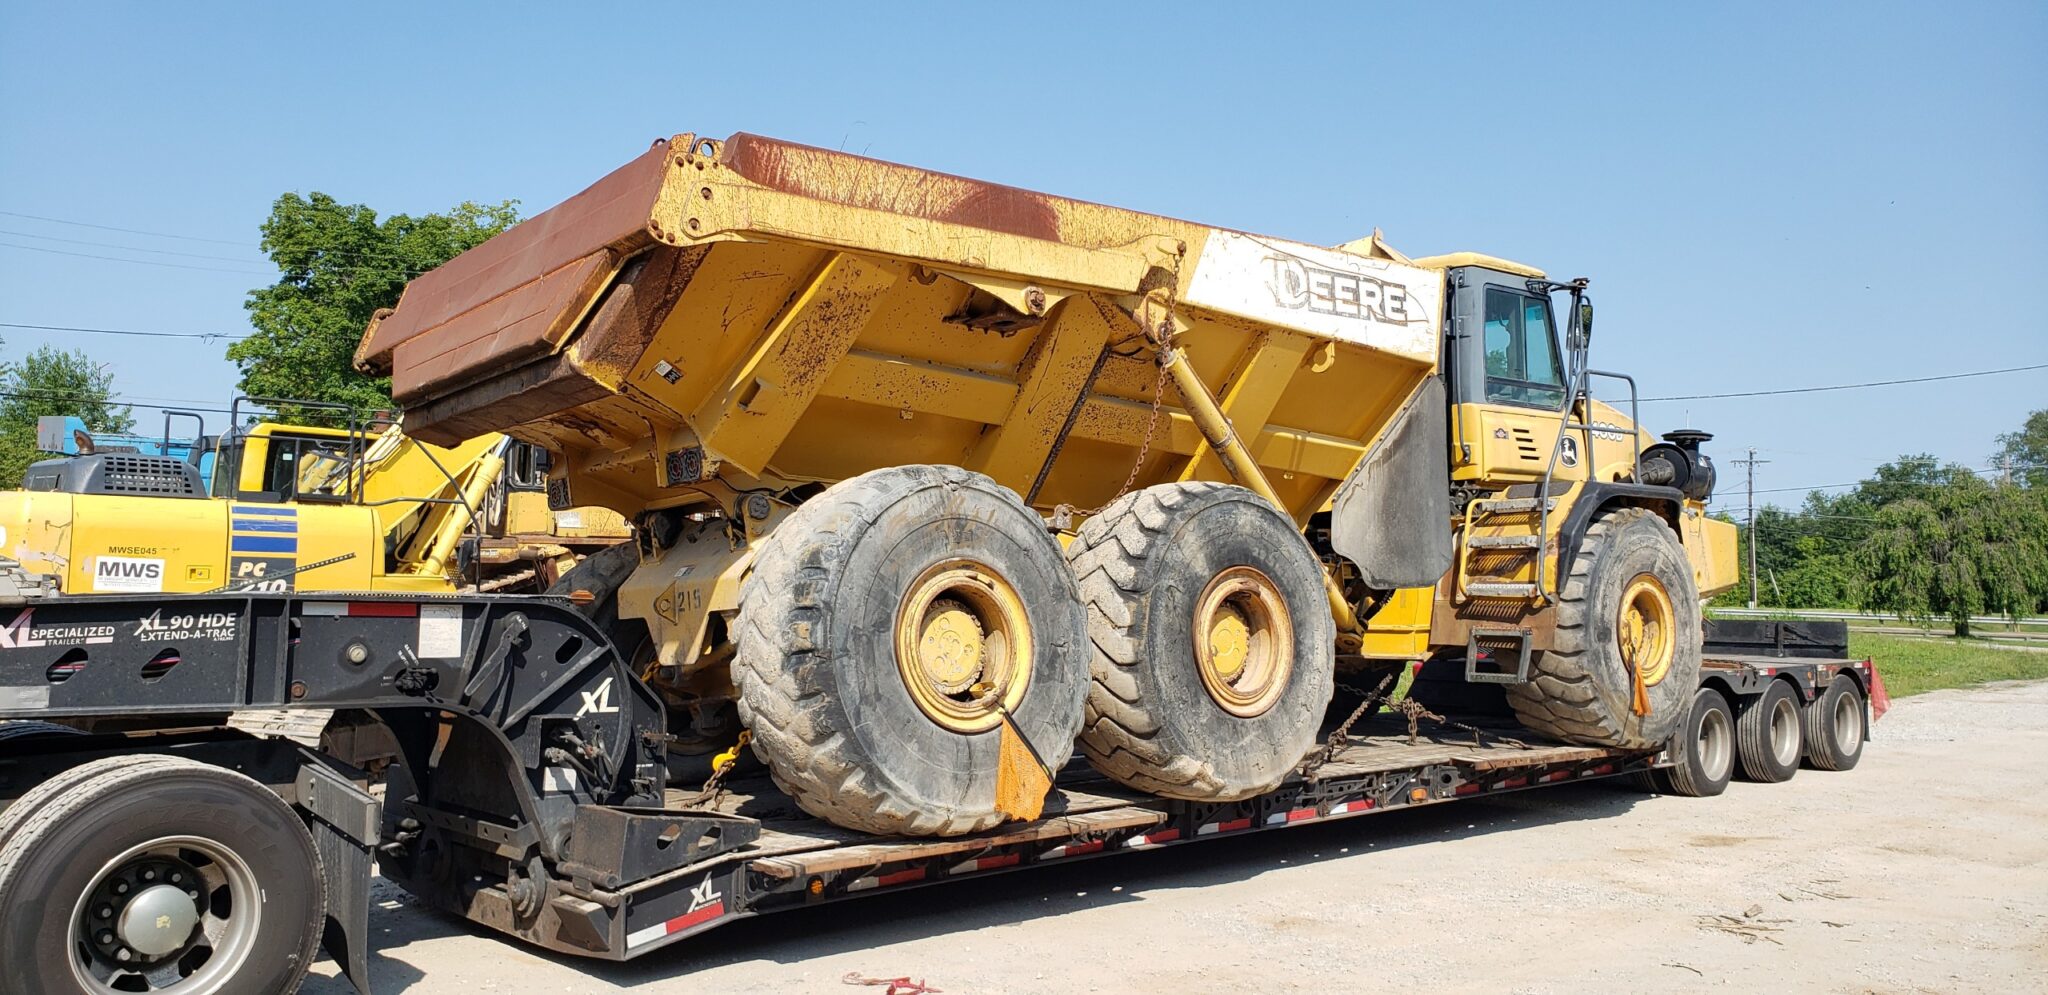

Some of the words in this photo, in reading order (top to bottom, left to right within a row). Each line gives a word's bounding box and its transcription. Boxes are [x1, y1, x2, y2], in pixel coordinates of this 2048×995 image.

[1264, 252, 1408, 327] DEERE
[108, 546, 157, 555] MWSE045
[98, 561, 160, 579] MWS
[238, 561, 267, 577] PC
[133, 608, 168, 636] XL
[170, 614, 194, 629] 90
[198, 612, 237, 628] HDE
[31, 626, 115, 639] SPECIALIZED
[140, 628, 235, 641] EXTEND-A-TRAC
[573, 677, 619, 720] XL
[687, 870, 722, 914] XL
